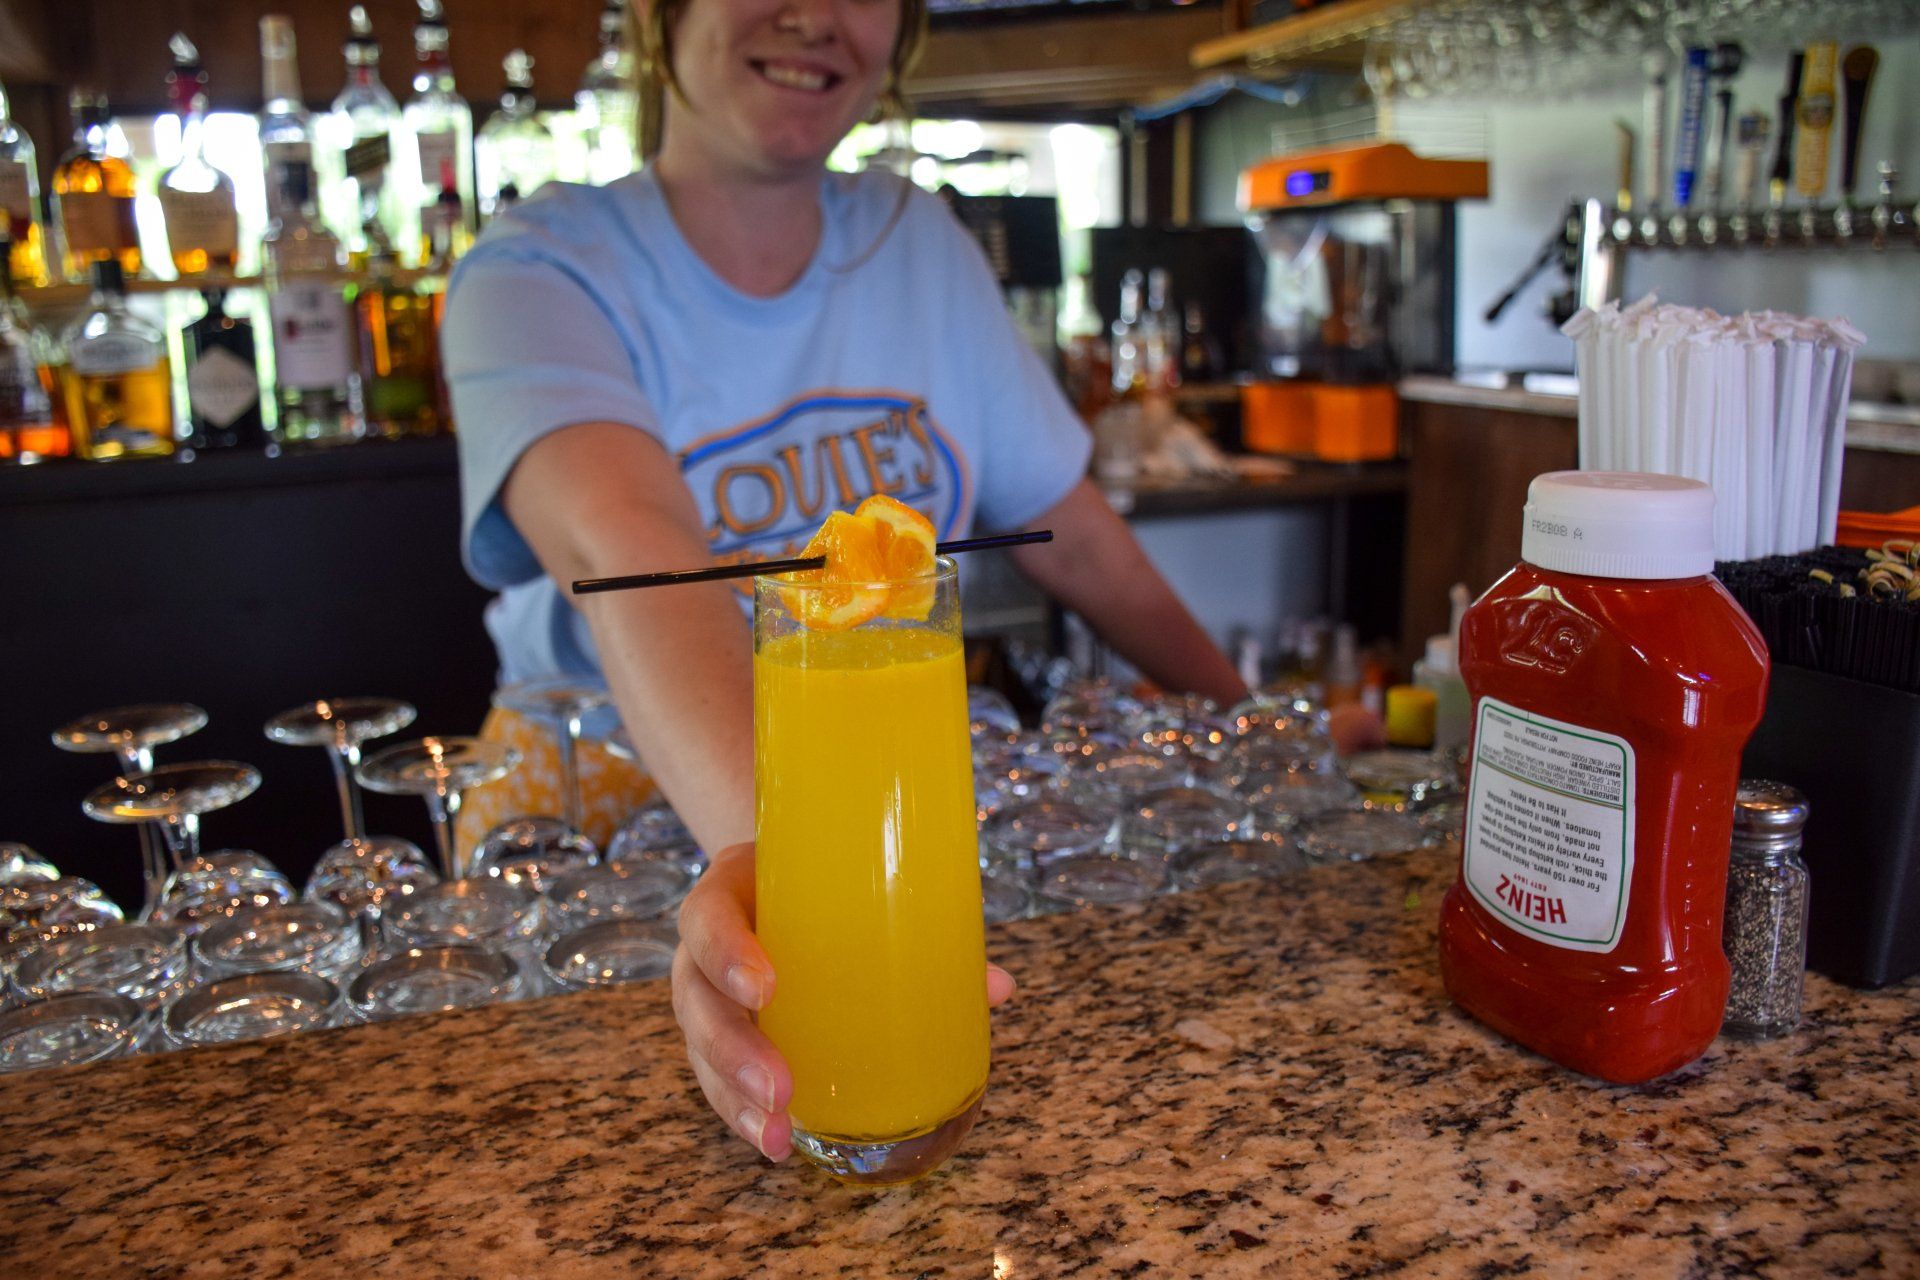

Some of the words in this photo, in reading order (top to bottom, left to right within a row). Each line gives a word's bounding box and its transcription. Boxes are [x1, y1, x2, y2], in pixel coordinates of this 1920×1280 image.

[708, 399, 937, 538] OUIE'S
[1571, 752, 1587, 764] FOODS
[1588, 756, 1603, 767] HEINZ
[1578, 761, 1620, 778] MANUFACTURED
[1604, 760, 1621, 771] KRAFT
[1592, 782, 1620, 795] DISTILLED
[1507, 801, 1512, 810] to
[1528, 797, 1536, 808] Be
[1538, 801, 1544, 810] to
[1514, 804, 1533, 818] comes
[1546, 804, 1559, 815] Has
[1561, 808, 1566, 818] It
[1504, 814, 1516, 825] best
[1535, 813, 1539, 821] it
[1541, 815, 1560, 829] When
[1518, 819, 1527, 830] the
[1529, 822, 1542, 834] only
[1503, 825, 1526, 842] Ketchup
[1544, 829, 1560, 841] from
[1492, 833, 1514, 848] America
[1527, 836, 1545, 850] Heinz
[1562, 834, 1585, 847] made,
[1516, 844, 1527, 855] that
[1556, 844, 1581, 859] variety
[1588, 842, 1600, 851] not
[1502, 850, 1512, 860] has
[1528, 848, 1554, 865] ketchup
[1583, 853, 1604, 867] Every
[1512, 855, 1530, 869] Heinz
[1556, 860, 1569, 869] rich
[1553, 871, 1566, 882] 150
[1568, 876, 1585, 887] over
[1595, 871, 1607, 882] the
[1587, 882, 1600, 893] For
[1495, 874, 1567, 924] HEINZ
